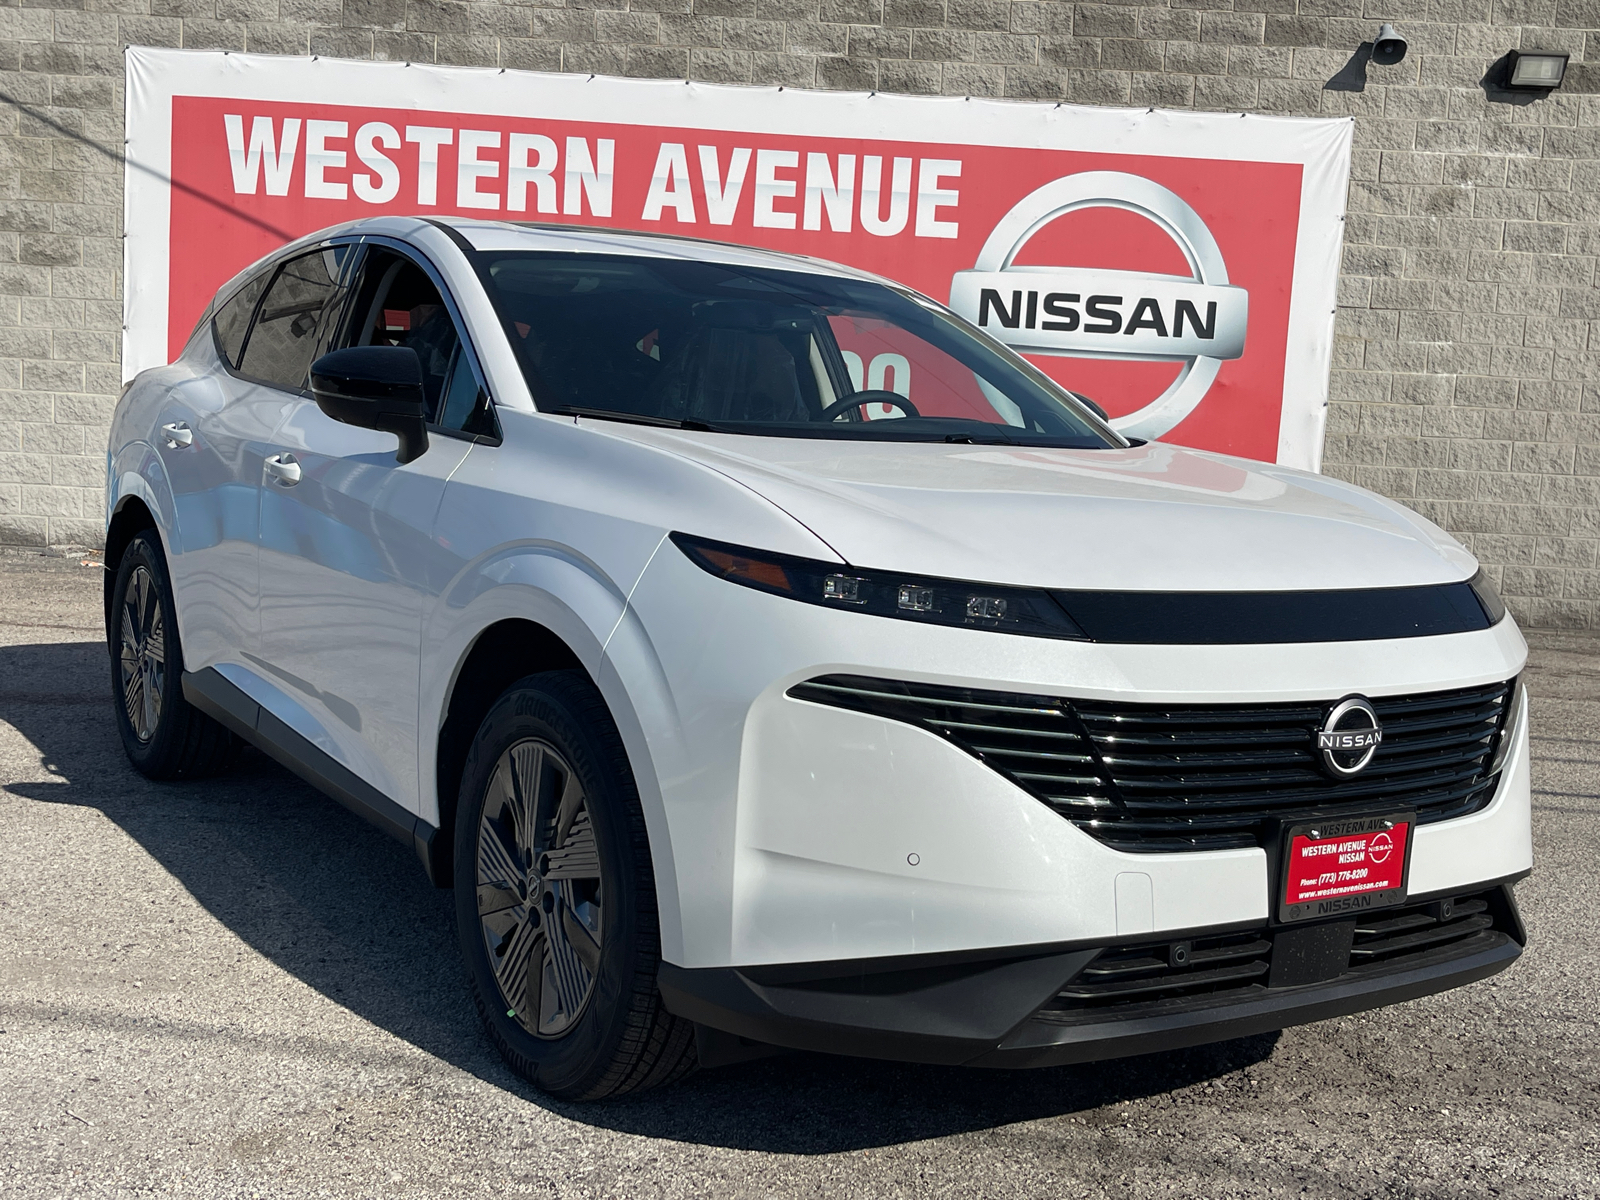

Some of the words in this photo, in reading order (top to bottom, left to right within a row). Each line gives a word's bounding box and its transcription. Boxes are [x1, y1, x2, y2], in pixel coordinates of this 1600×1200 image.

[224, 113, 616, 218] WESTERN
[642, 142, 963, 239] AVENUE
[979, 288, 1217, 340] NISSAN
[1320, 731, 1382, 748] NISSAN
[1320, 822, 1365, 836] WESTERN
[1302, 844, 1337, 857] WESTERN
[1338, 840, 1366, 852] AVENUE
[1368, 844, 1393, 852] NISSAN
[1339, 852, 1365, 864] NISSAN
[1300, 878, 1317, 886] Phone:
[1318, 872, 1336, 886] (773)
[1299, 880, 1388, 899] www.westernavenissan.com
[1318, 895, 1371, 914] NISSAN
